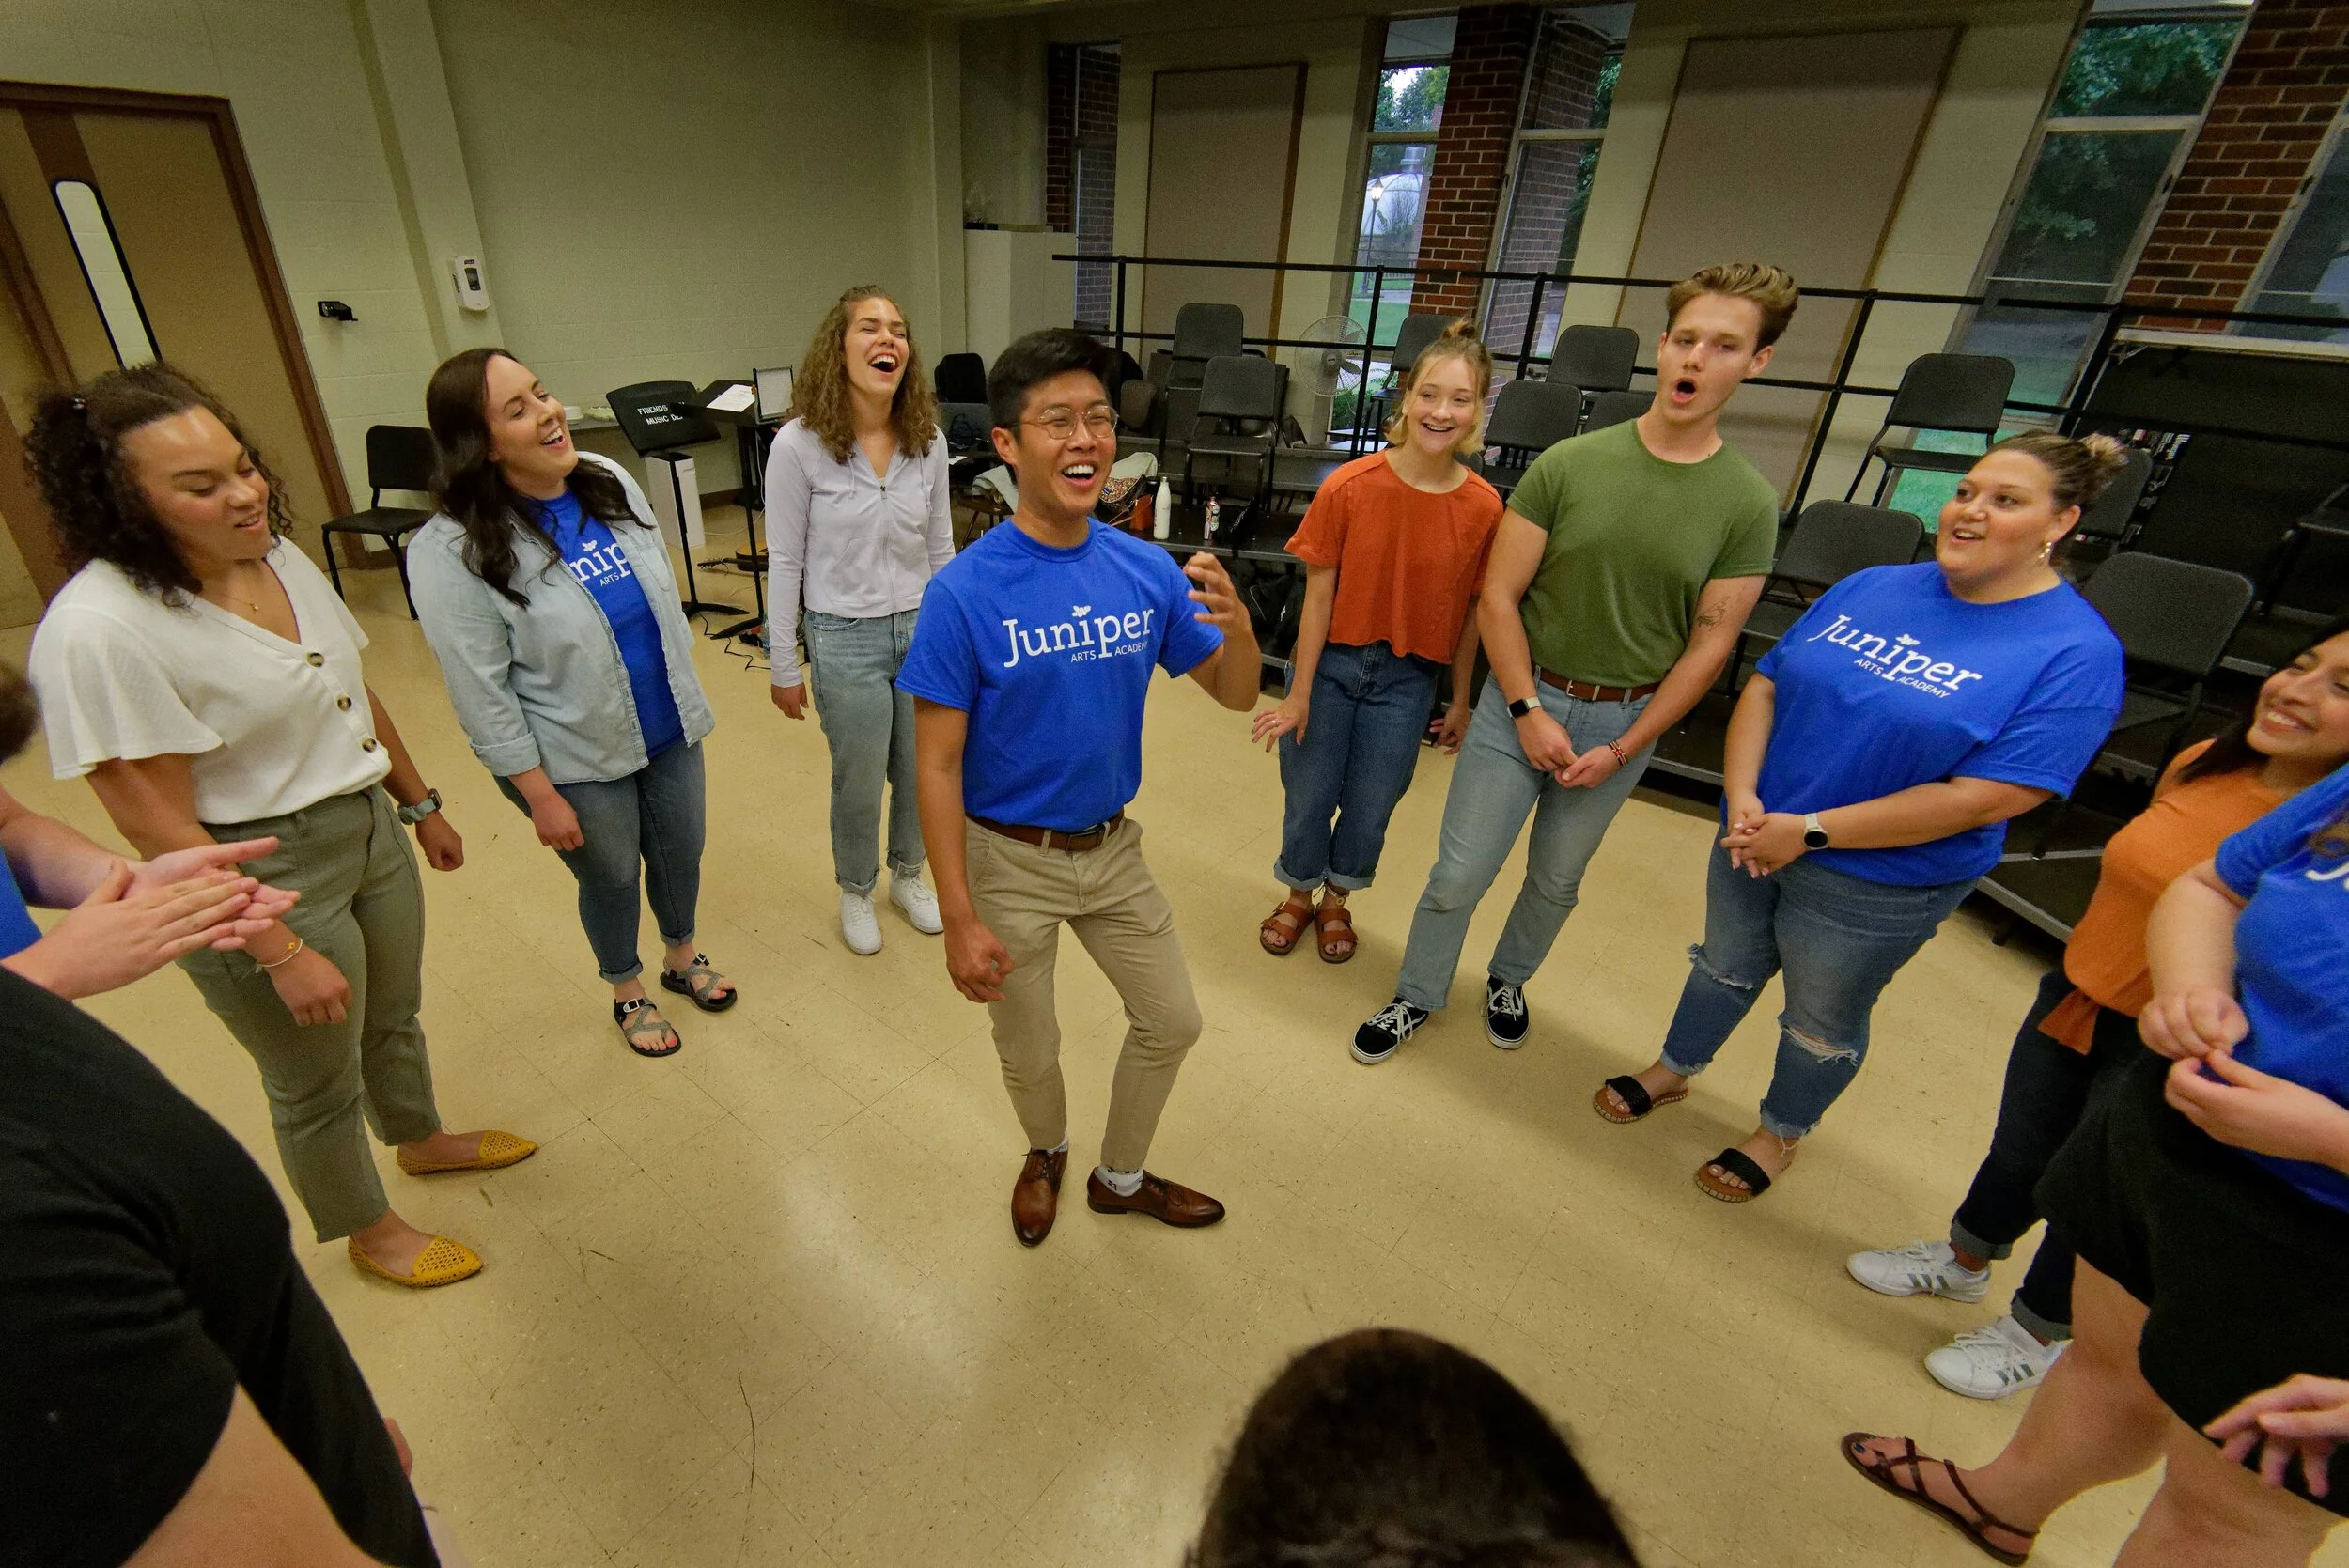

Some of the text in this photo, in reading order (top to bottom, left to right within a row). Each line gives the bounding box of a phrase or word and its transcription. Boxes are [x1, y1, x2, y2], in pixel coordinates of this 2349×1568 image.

[637, 404, 669, 415] FRIENDS
[645, 415, 670, 426] MUSIC
[599, 572, 620, 586] ARTS
[1003, 605, 1155, 668] Juniper
[1070, 649, 1097, 663] ARTS
[1806, 614, 1983, 691] Juniper
[1854, 658, 1951, 699] ARTS ACADEMY
